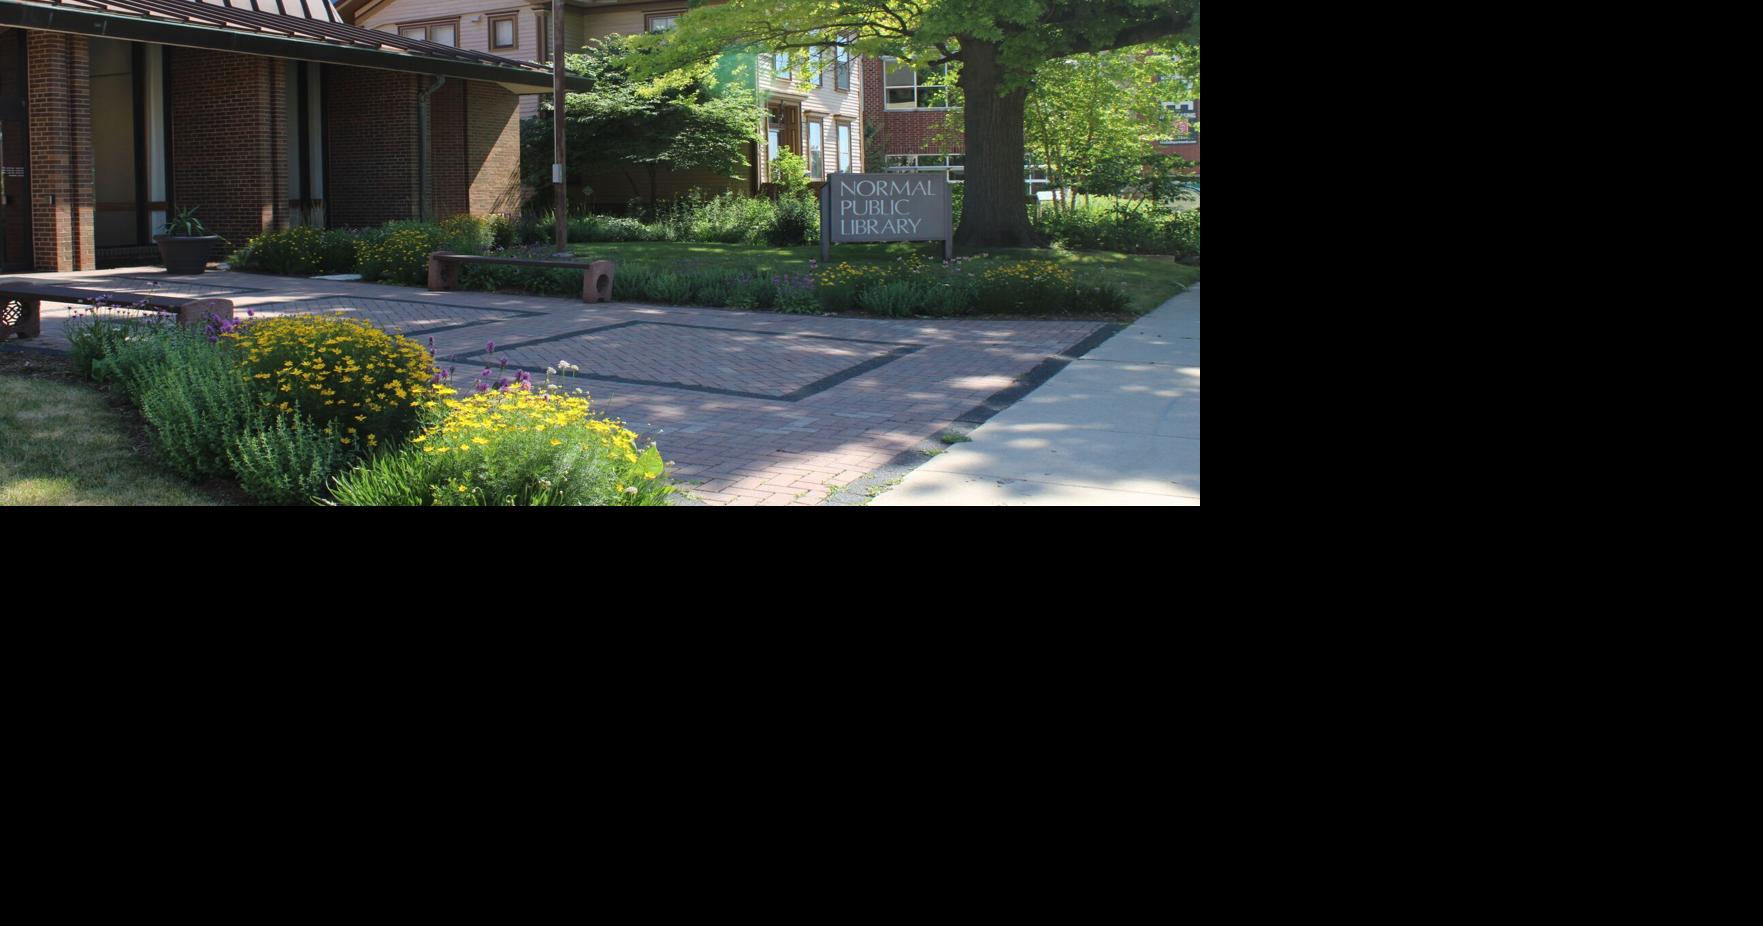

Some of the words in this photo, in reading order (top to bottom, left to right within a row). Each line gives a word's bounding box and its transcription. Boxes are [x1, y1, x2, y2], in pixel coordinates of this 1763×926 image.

[840, 180, 936, 196] NORMAL
[840, 199, 910, 216] PUBLIC
[840, 218, 922, 235] LIBRARY
